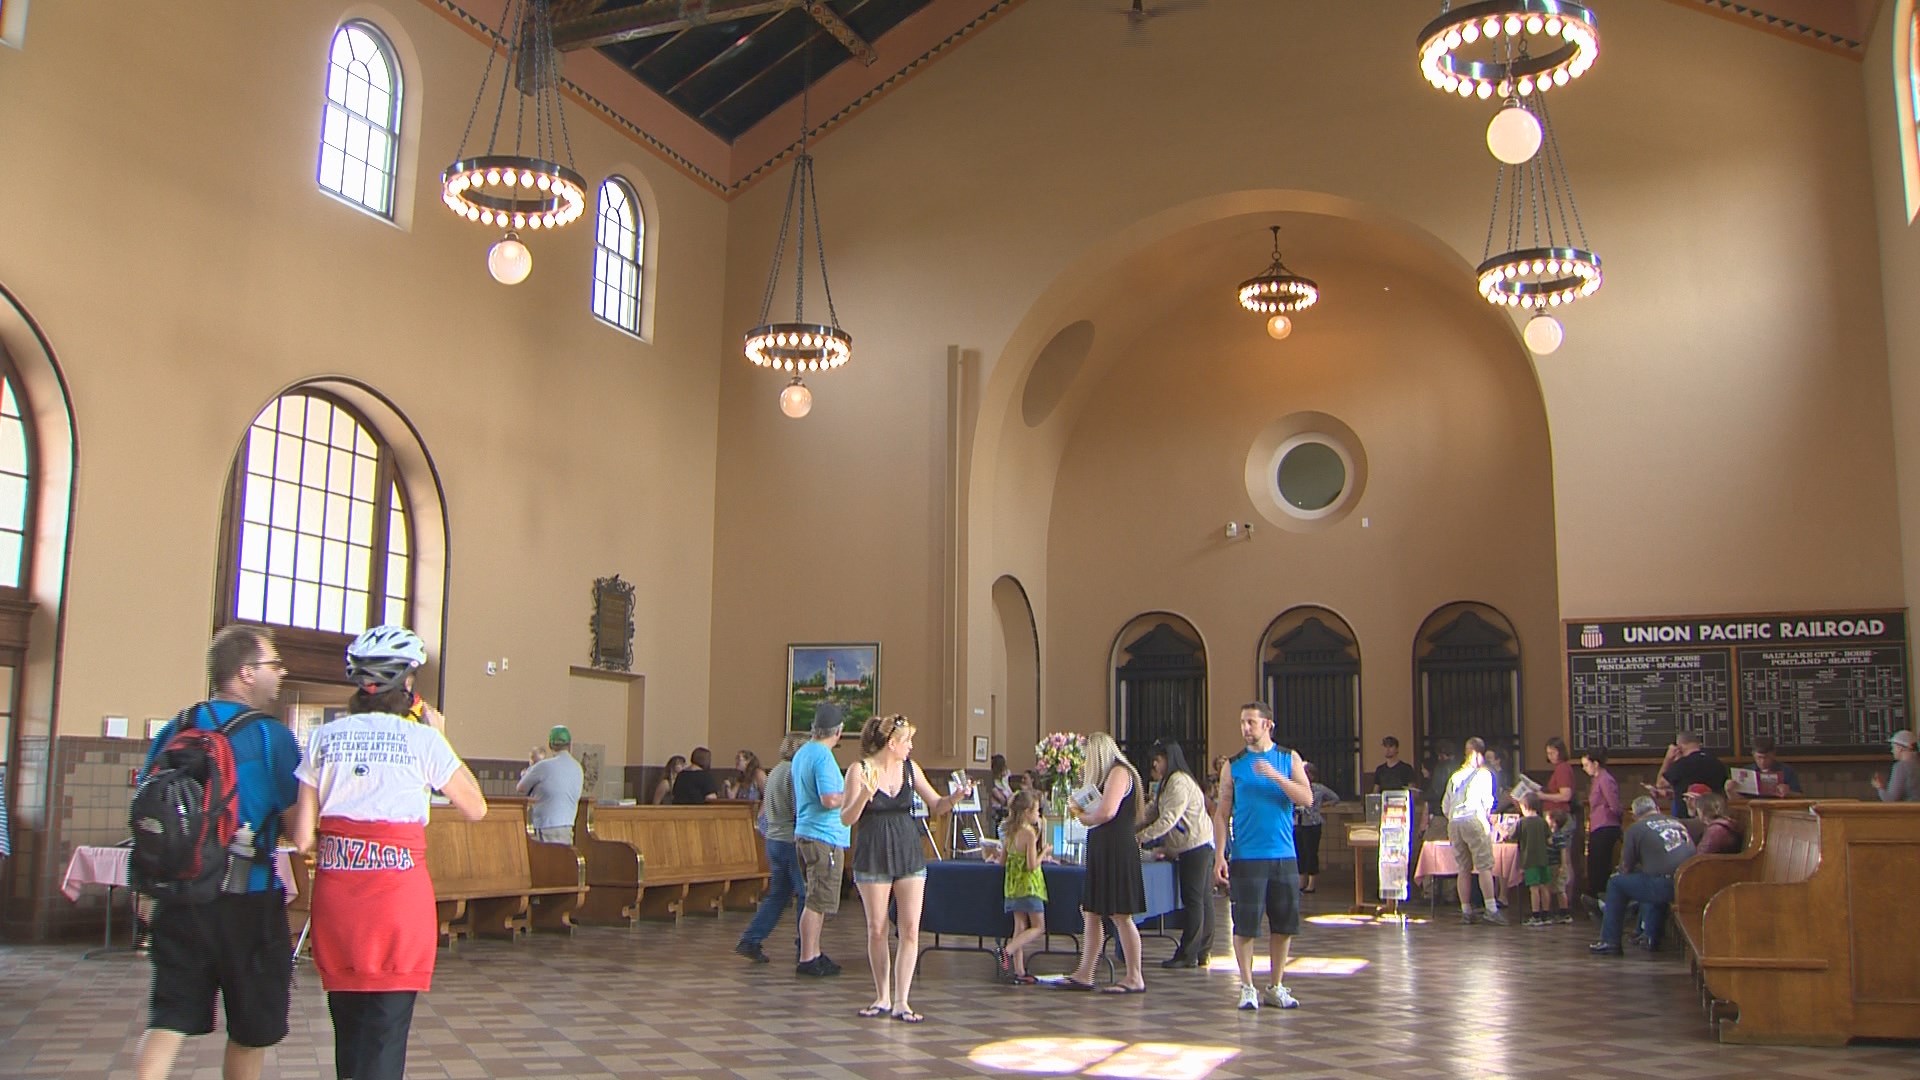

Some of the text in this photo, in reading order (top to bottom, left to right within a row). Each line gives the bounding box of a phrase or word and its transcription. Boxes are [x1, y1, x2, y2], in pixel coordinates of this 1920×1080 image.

[1623, 619, 1886, 643] UNION PACIFIC RAILROAD
[1646, 655, 1667, 663] CITY
[1771, 658, 1821, 666] PORTLAND
[1597, 663, 1650, 671] PENDLETON
[1657, 661, 1701, 669] SPOKANE
[330, 731, 348, 740] WISH
[349, 731, 353, 740] I
[354, 731, 375, 741] COULD
[377, 731, 385, 741] GO
[332, 742, 341, 752] TO
[342, 742, 369, 751] CHANGE
[344, 753, 352, 762] IT
[354, 752, 368, 763] ALL
[369, 752, 388, 763] OVER
